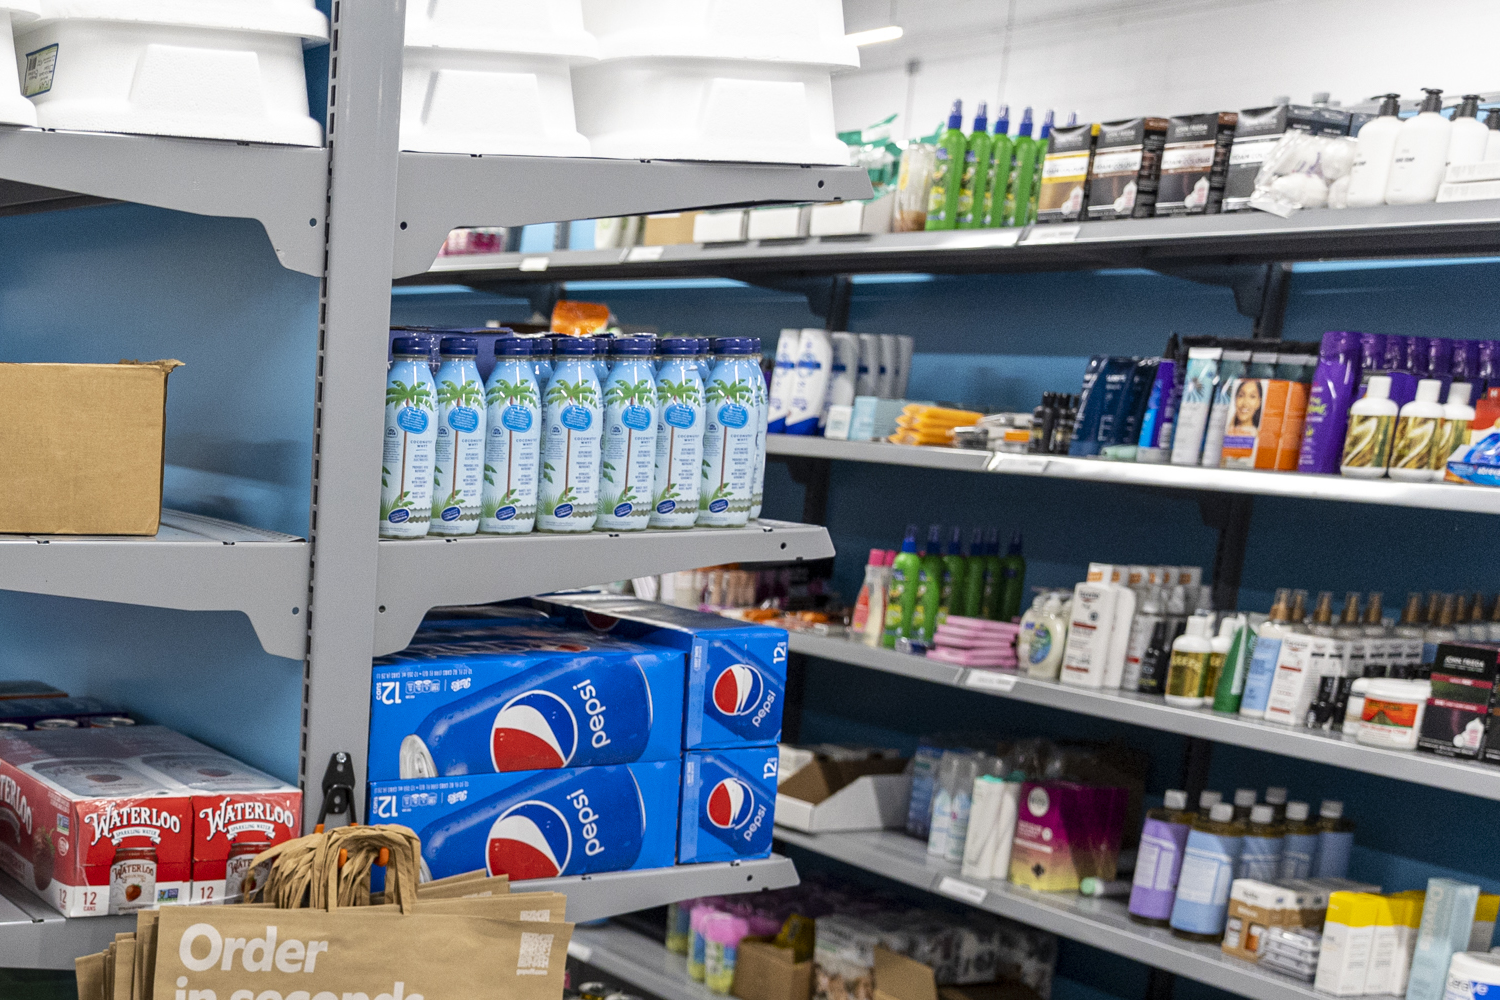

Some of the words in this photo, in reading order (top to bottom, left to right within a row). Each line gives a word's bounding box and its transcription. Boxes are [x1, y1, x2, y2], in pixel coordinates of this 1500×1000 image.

[773, 645, 786, 664] 12
[382, 681, 402, 705] 12
[573, 679, 611, 749] pepsi
[752, 689, 777, 727] pepsi
[763, 762, 777, 780] 12
[378, 795, 398, 818] 12
[83, 801, 181, 846] WATERLOO
[199, 797, 295, 841] WATERLOO
[231, 823, 257, 832] SPARKLING
[258, 823, 273, 831] WATER
[567, 788, 605, 856] pepsi
[743, 804, 767, 842] pepsi
[115, 829, 142, 838] SPARKLING
[143, 828, 159, 836] WATER
[111, 861, 155, 879] WATERLOO
[83, 891, 98, 906] 12
[200, 886, 215, 900] 12
[179, 922, 328, 973] Order
